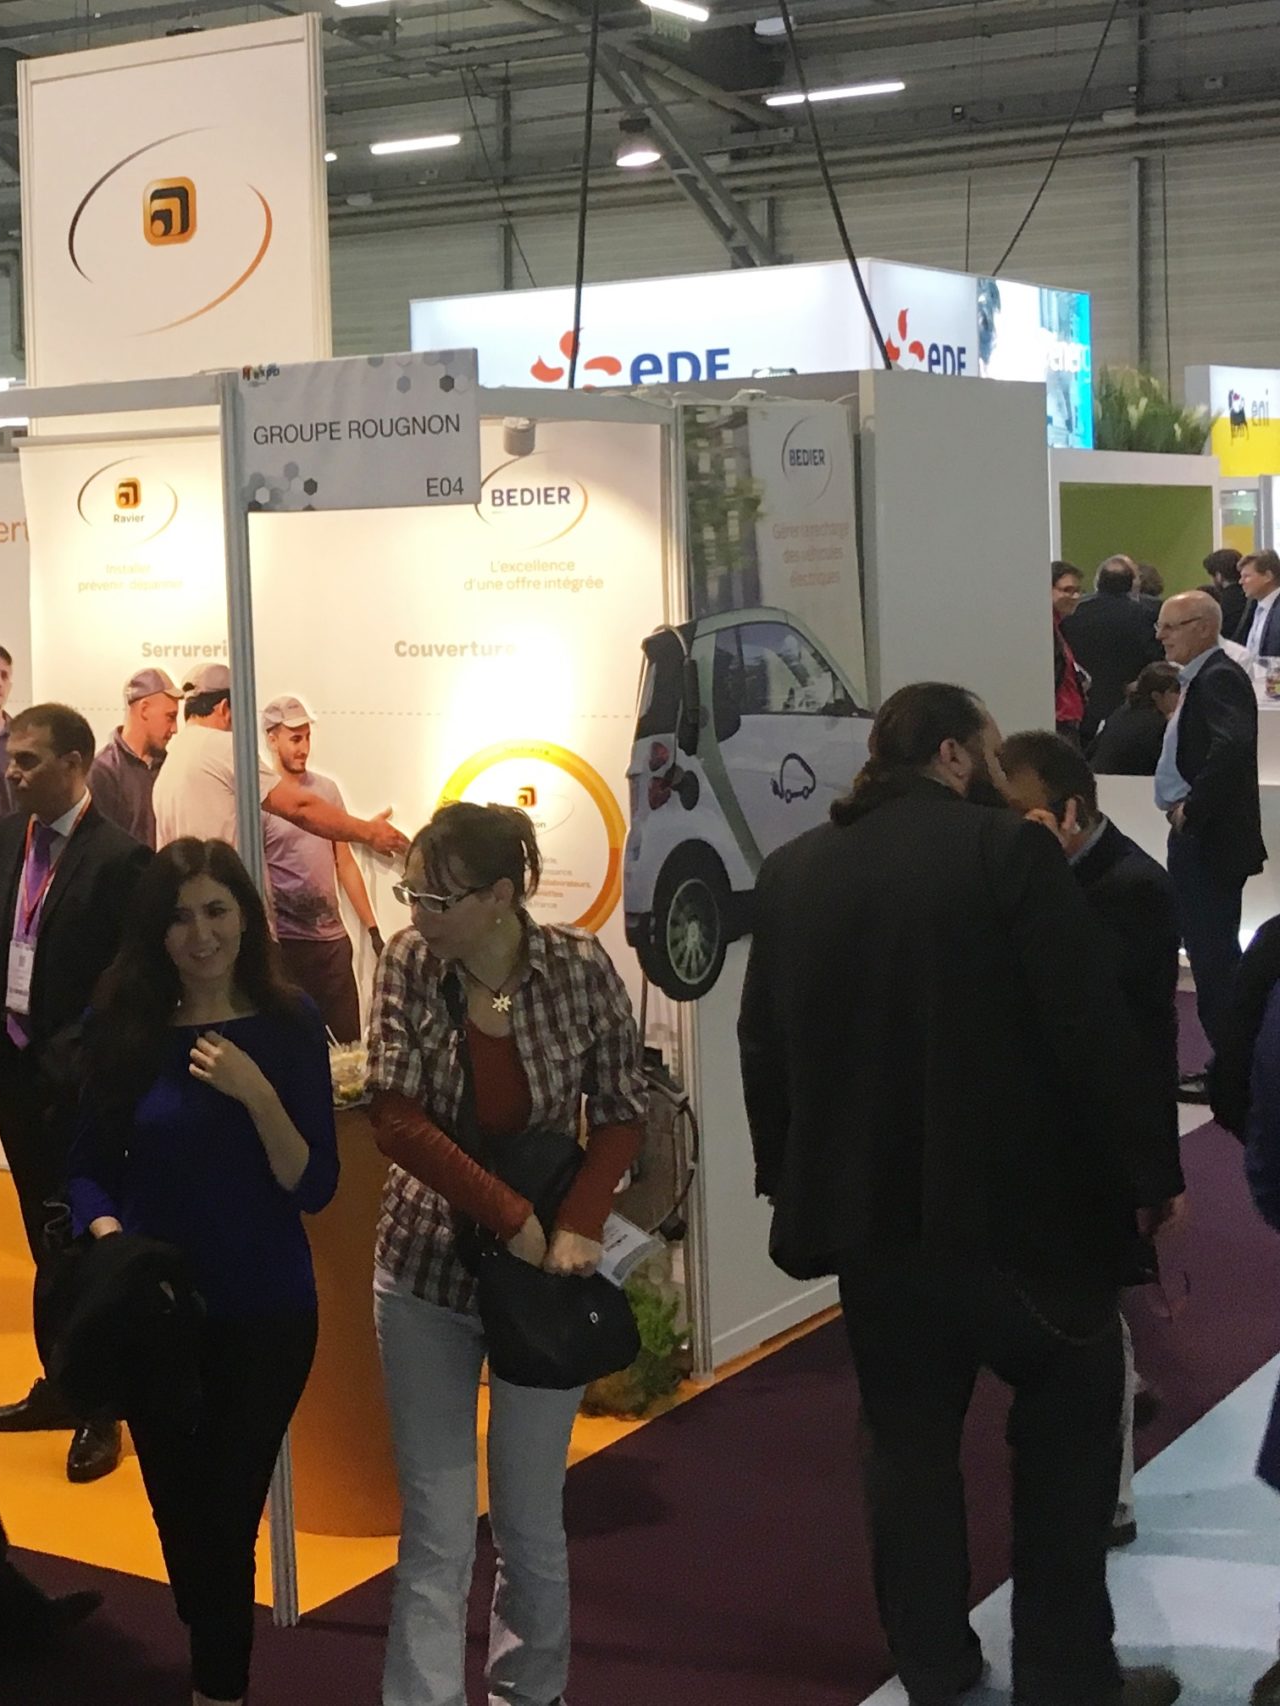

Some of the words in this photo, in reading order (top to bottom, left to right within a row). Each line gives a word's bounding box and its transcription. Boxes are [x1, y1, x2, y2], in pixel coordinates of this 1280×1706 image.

[253, 421, 342, 445] GROUPE
[348, 414, 461, 440] ROUGNON
[789, 449, 825, 466] BEDIER
[426, 477, 464, 497] E04
[491, 486, 571, 507] BEDIER
[113, 514, 145, 523] Ravier
[490, 560, 576, 574] L'excellence
[464, 577, 503, 591] d'une
[507, 576, 541, 590] offre
[544, 575, 604, 593] intégrée
[394, 640, 516, 657] Couverture
